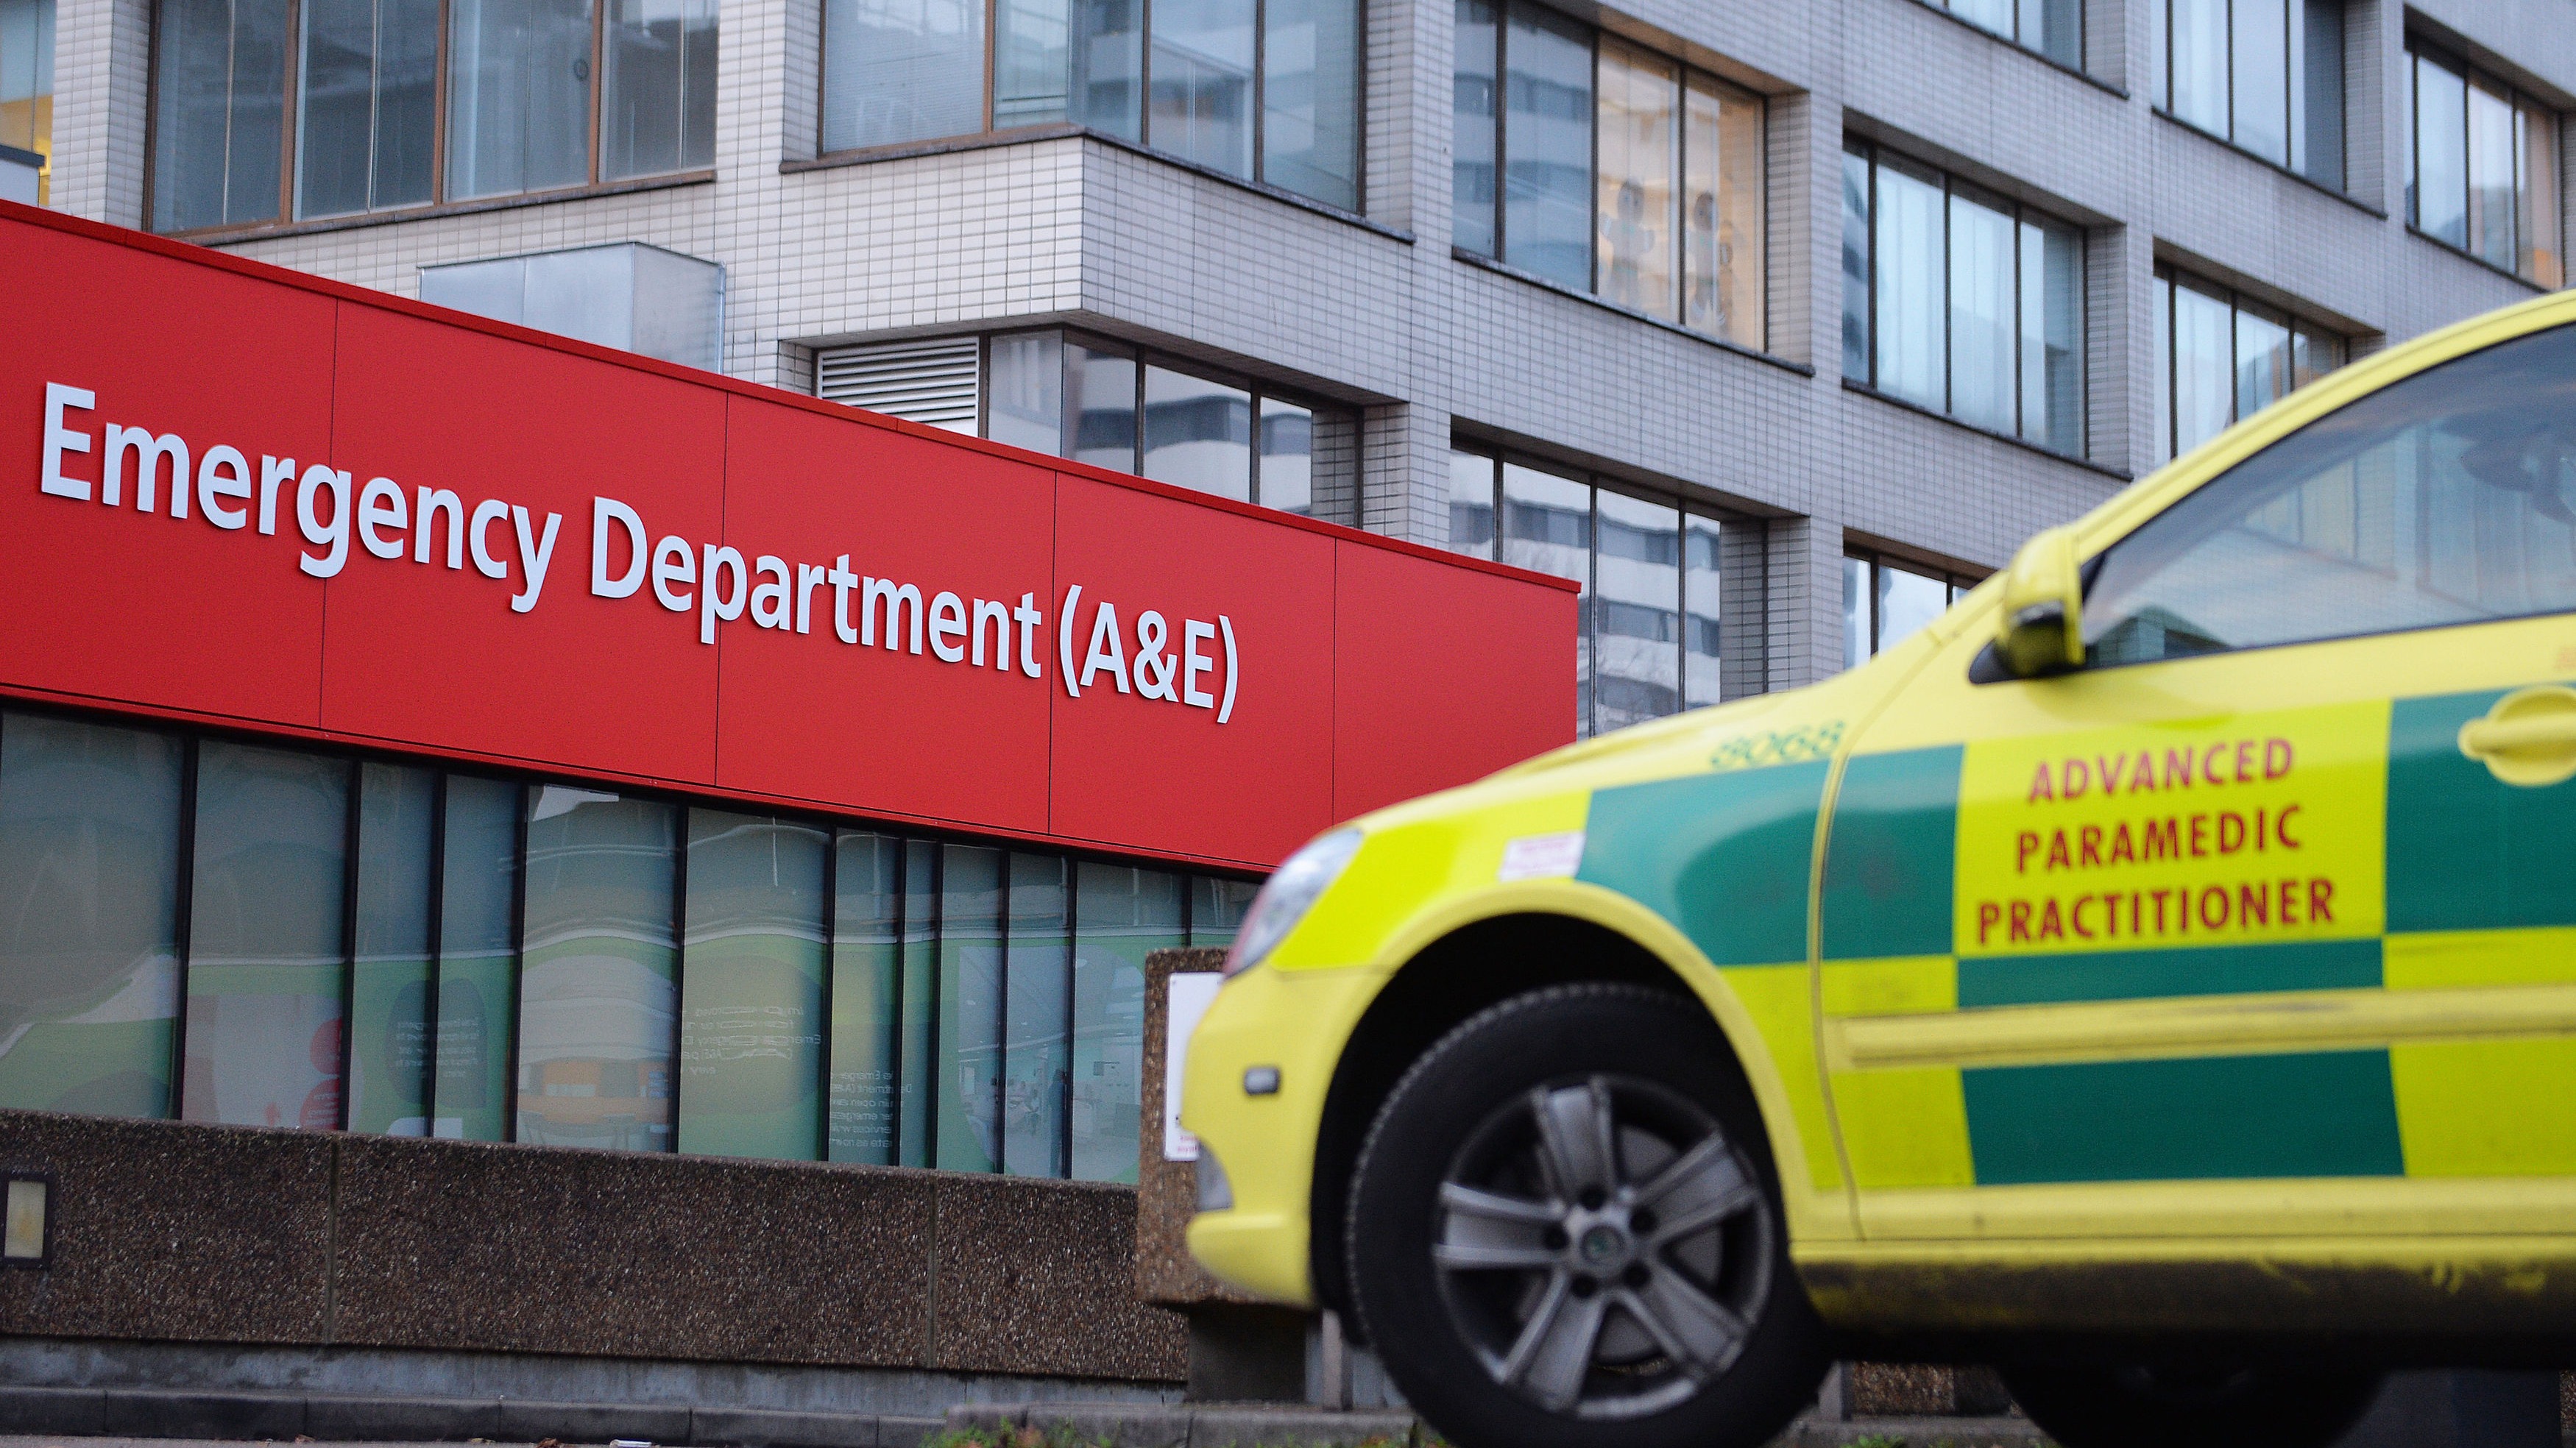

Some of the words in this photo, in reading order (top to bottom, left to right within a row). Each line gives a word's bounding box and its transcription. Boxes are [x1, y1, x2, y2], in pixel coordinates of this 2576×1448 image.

[41, 381, 563, 614] Emergency
[590, 496, 1042, 678] Department
[1059, 584, 1238, 723] (A&E)
[2028, 737, 2293, 804] ADVANCED
[2017, 805, 2302, 873] PARAMEDIC
[1978, 878, 2335, 945] PRACTITIONER
